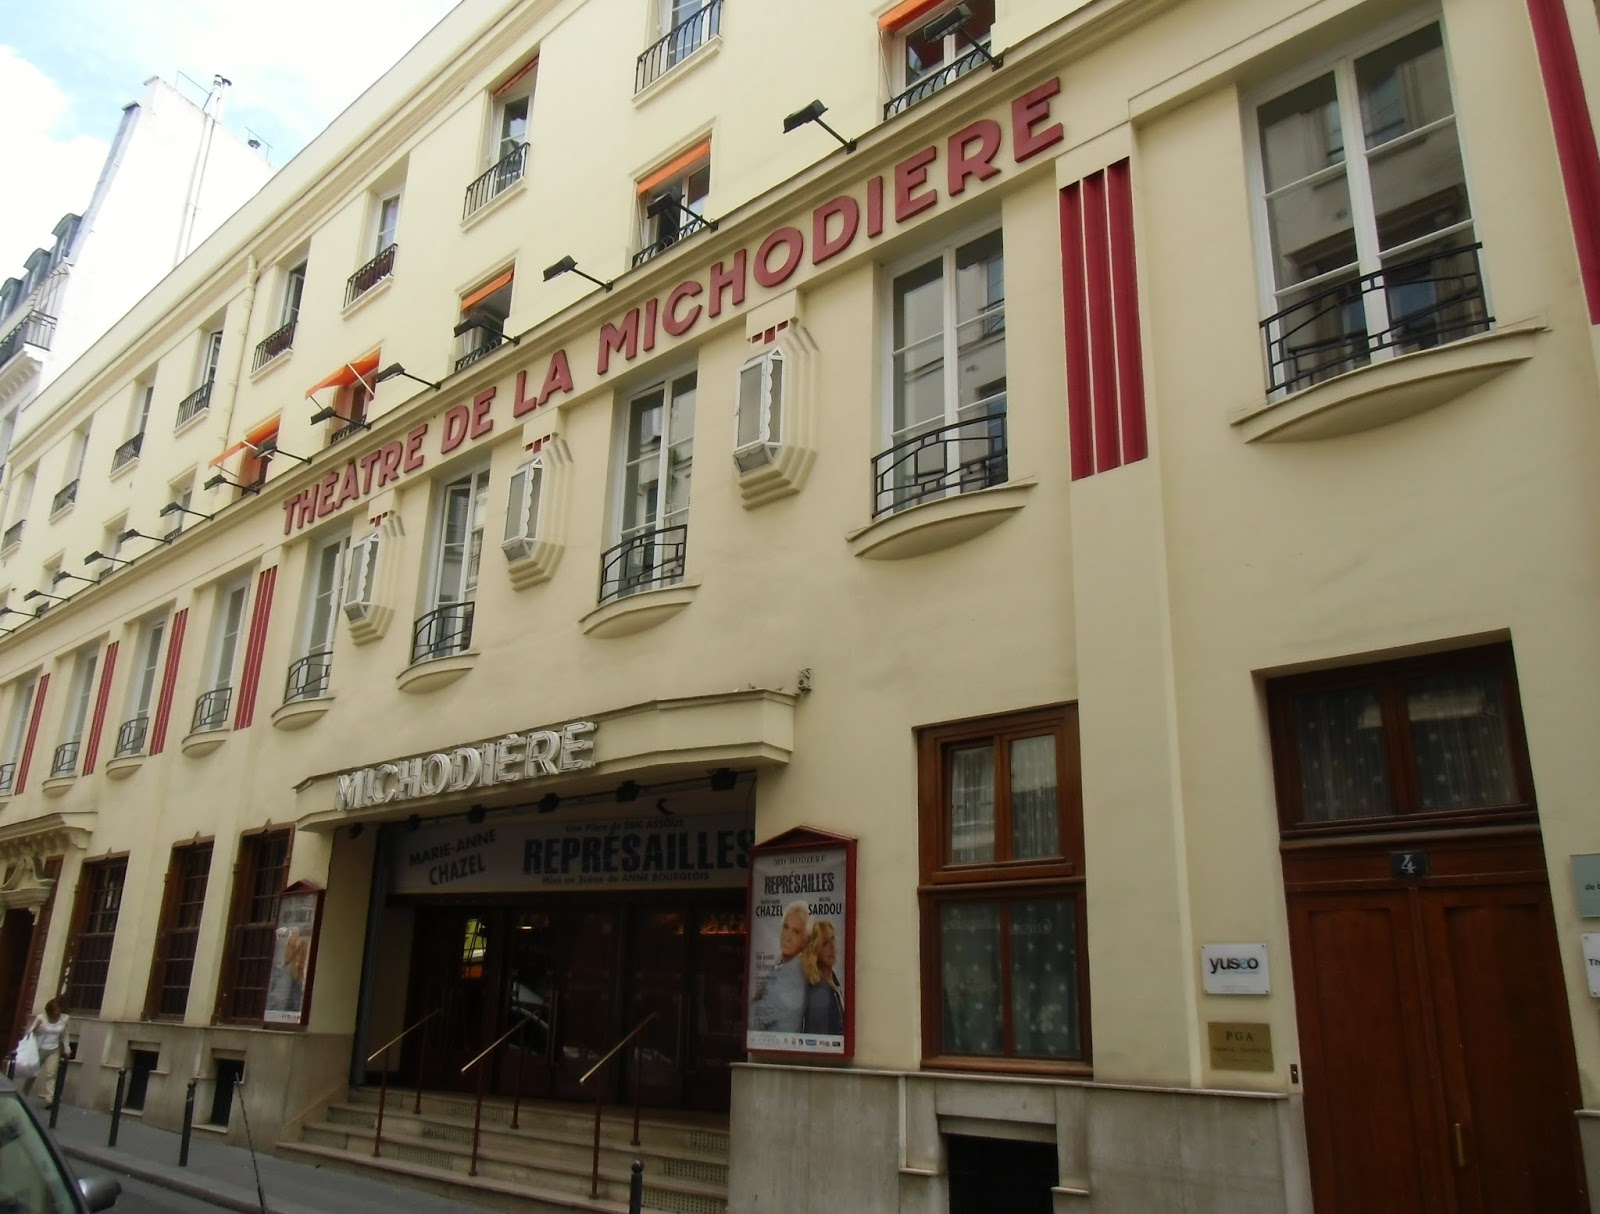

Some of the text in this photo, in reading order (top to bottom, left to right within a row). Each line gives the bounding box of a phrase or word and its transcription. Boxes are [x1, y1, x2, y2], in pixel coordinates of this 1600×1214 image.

[440, 385, 497, 455] DE
[512, 349, 574, 419] LA
[596, 76, 1064, 375] MICHODIERE
[408, 828, 497, 867] MARIE-ANNE
[429, 852, 486, 886] CHAZEL
[1401, 854, 1416, 874] 4
[621, 872, 649, 882] ANNE
[652, 870, 710, 882] BOURGEOIS
[764, 871, 835, 894] REPRÉSAILLES
[755, 904, 783, 917] CHAZEL
[808, 903, 842, 916] SARDOU
[1208, 957, 1259, 974] yuseo
